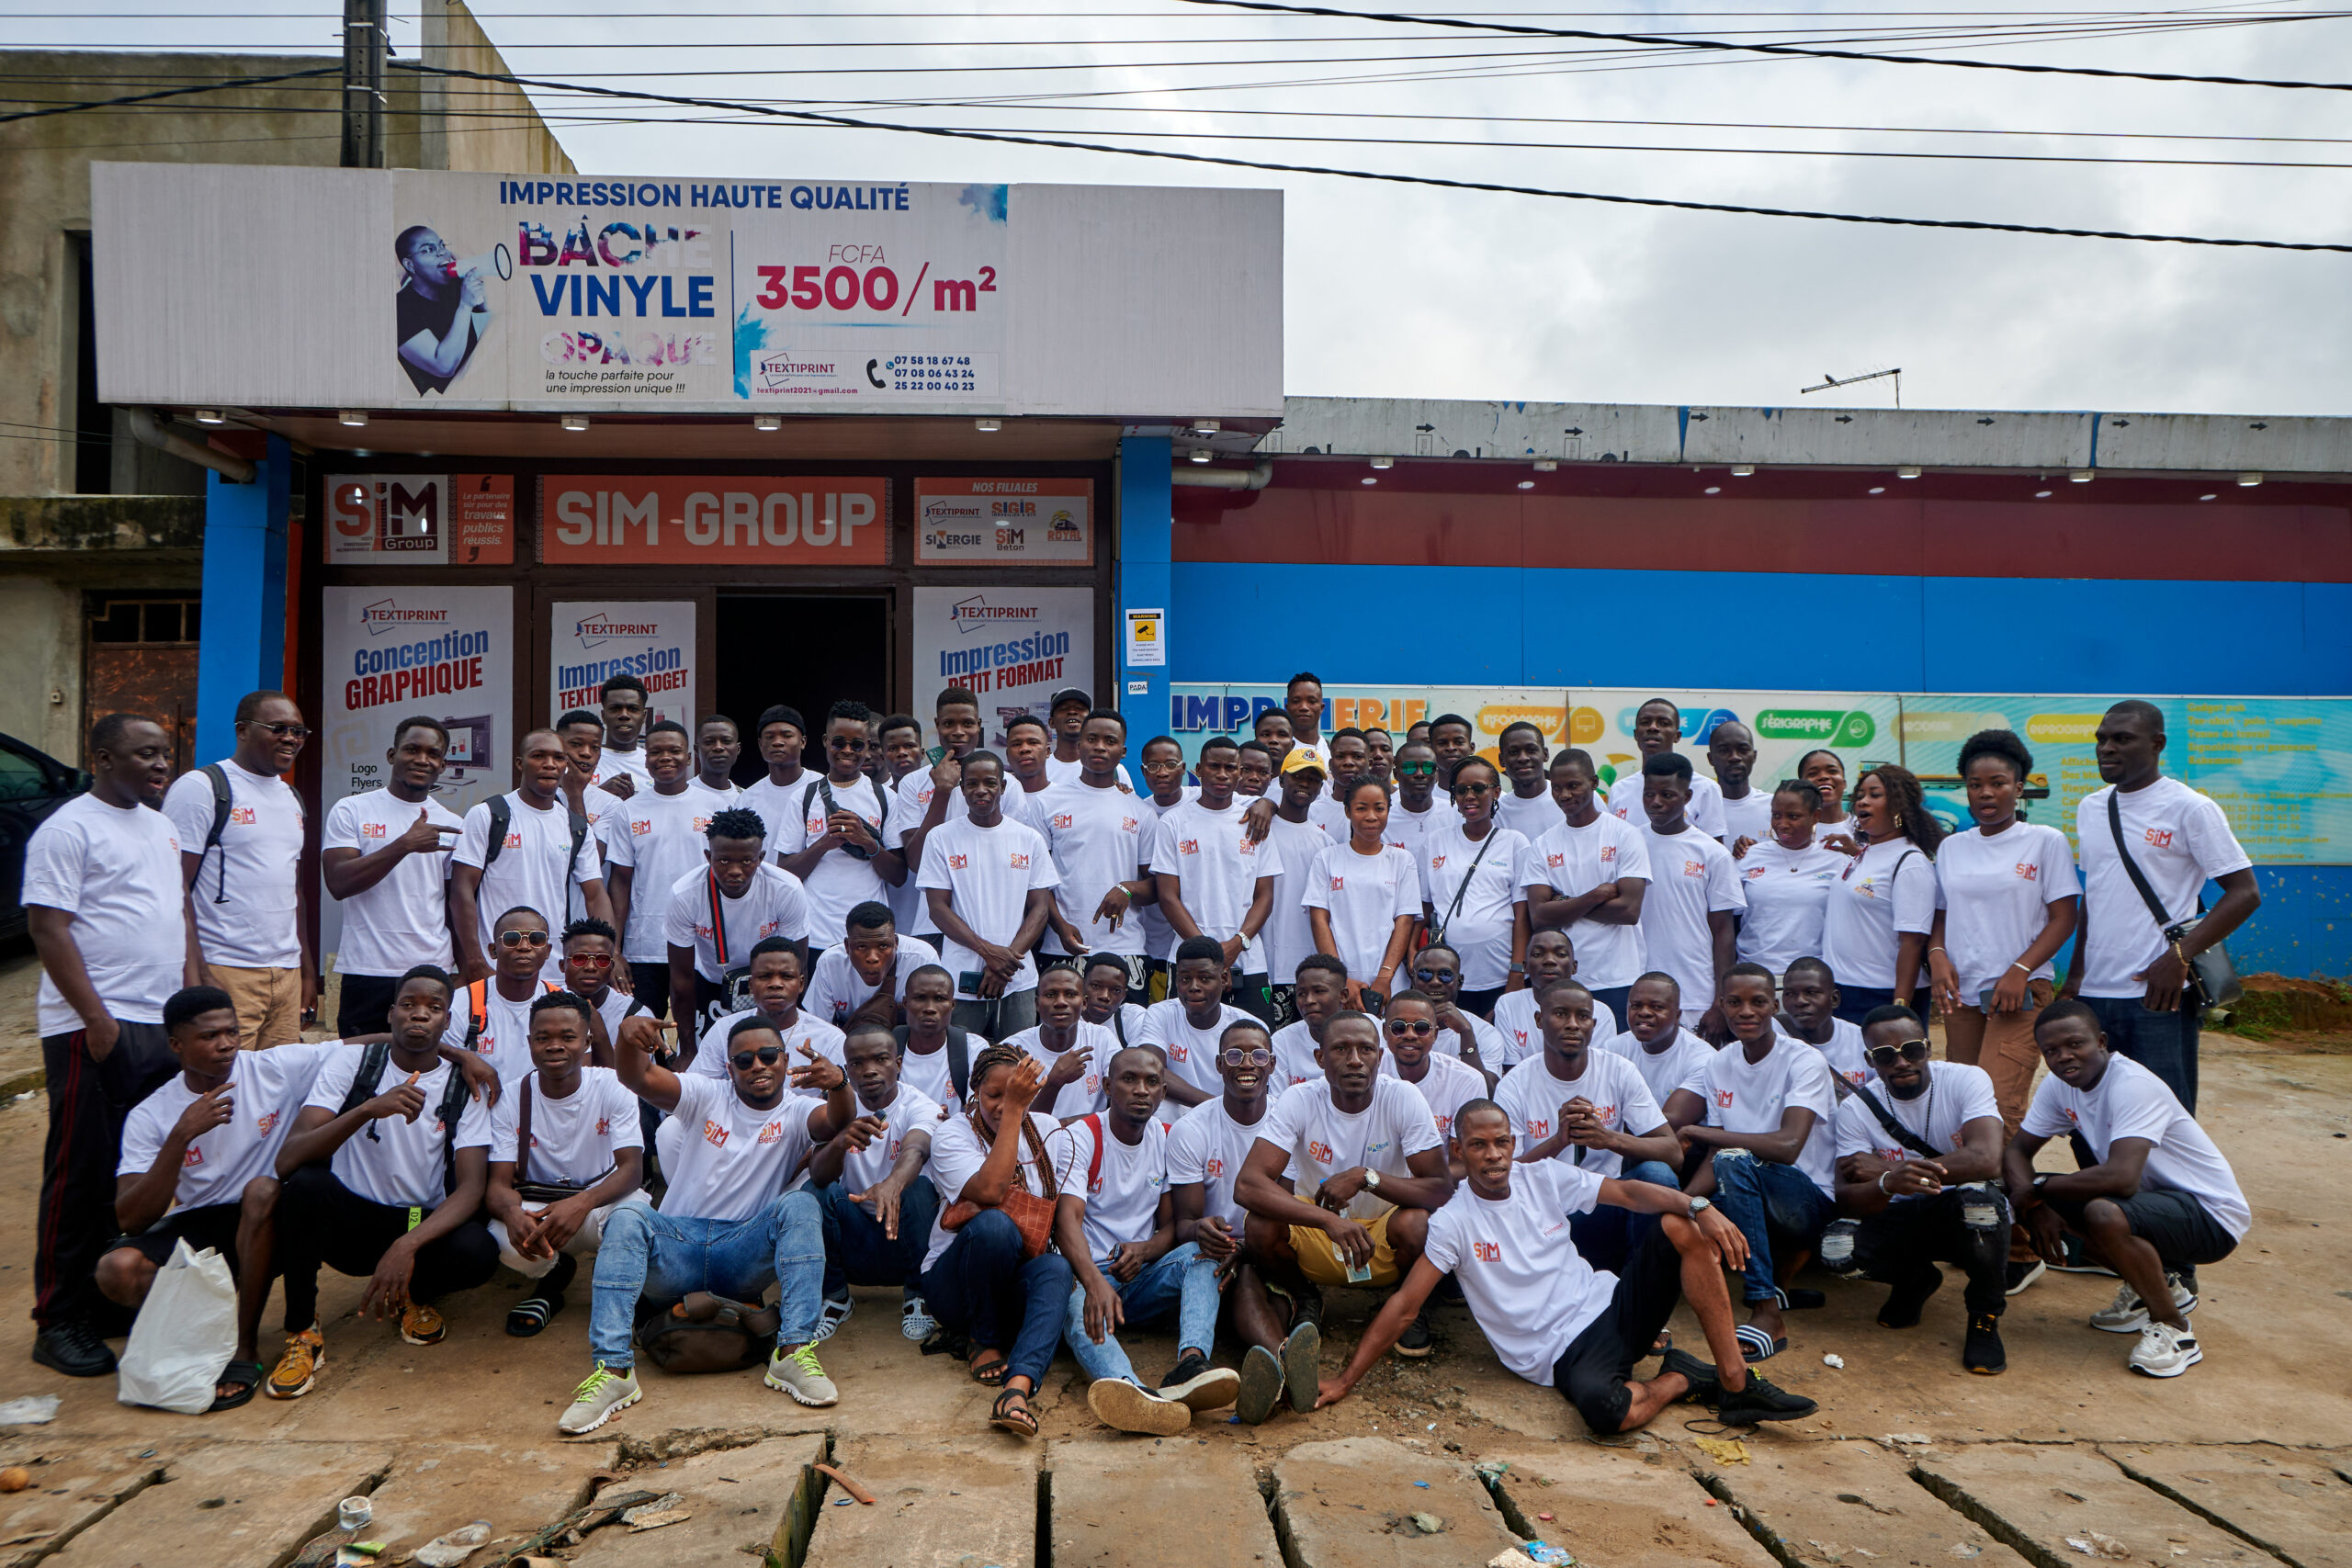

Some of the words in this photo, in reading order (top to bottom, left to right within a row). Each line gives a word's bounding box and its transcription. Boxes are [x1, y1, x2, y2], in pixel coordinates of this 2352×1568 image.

[500, 181, 681, 207] IMPRESSION
[692, 184, 781, 209] HAUTE
[790, 182, 910, 210] QUALITÉ
[519, 214, 712, 267] BÂCHE
[829, 244, 885, 264] FCFA
[530, 274, 715, 317] VINYLE
[540, 331, 717, 367] OPAQUE
[768, 363, 835, 373] TEXTIPRINT
[895, 356, 907, 365] 07
[910, 356, 923, 365] 58
[927, 356, 939, 365] 18
[942, 356, 954, 366] 67
[956, 356, 970, 366] 48
[546, 369, 555, 380] la
[559, 370, 598, 380] touche
[601, 369, 644, 382] parfaite
[647, 372, 674, 382] pour
[895, 369, 906, 378] 07
[910, 369, 925, 378] 08
[928, 369, 942, 378] 06
[944, 369, 958, 378] 43
[961, 369, 975, 378] 24
[546, 384, 567, 393] une
[570, 383, 631, 395] impression
[634, 383, 673, 395] unique
[675, 383, 685, 393] !!!
[895, 381, 908, 390] 25
[910, 381, 924, 390] 22
[927, 381, 942, 390] 00
[944, 381, 958, 390] 40
[961, 381, 975, 390] 23
[972, 482, 994, 492] NOS
[996, 482, 1038, 492] FILIALES
[473, 492, 511, 501] partenaire
[464, 511, 506, 520] travaux
[556, 491, 659, 546] SIM
[684, 491, 876, 547] GROUP
[463, 523, 503, 535] publics
[996, 528, 1023, 545] SiM
[1047, 530, 1082, 541] ROYAL
[385, 537, 435, 550] Group
[463, 536, 503, 545] réussis.
[370, 610, 447, 621] TEXTIPRINT
[960, 607, 1038, 617] TEXTIPRINT
[583, 624, 658, 634] TEXTIPRINT
[355, 629, 489, 676] Conception
[940, 631, 1069, 677] Impression
[559, 647, 681, 690] Impression
[997, 657, 1064, 690] FORMAT
[345, 657, 483, 711] GRAPHIQUE
[639, 669, 688, 694] ADGET
[1170, 694, 1426, 733] IMPRERIE
[2222, 729, 2233, 738] de
[2236, 729, 2270, 738] travail
[351, 762, 378, 775] Logo
[351, 777, 382, 789] Flyers
[232, 808, 256, 824] SiM
[1054, 815, 1072, 829] SiM
[363, 823, 386, 839] SiM
[632, 819, 651, 836] SiM
[1180, 839, 1199, 854] SiM
[2143, 829, 2173, 850] SiM
[949, 853, 968, 870] SiM
[1011, 853, 1029, 865] SiM
[1547, 853, 1565, 868] SiM
[1685, 861, 1705, 874] SiM
[2016, 863, 2038, 881] SiM
[1330, 875, 1344, 891] iM
[1170, 1044, 1188, 1064] SiM
[704, 1119, 730, 1148] SiM
[1527, 1119, 1550, 1140] SiM
[1308, 1141, 1333, 1165] SiM
[1473, 1242, 1501, 1263] SiM
